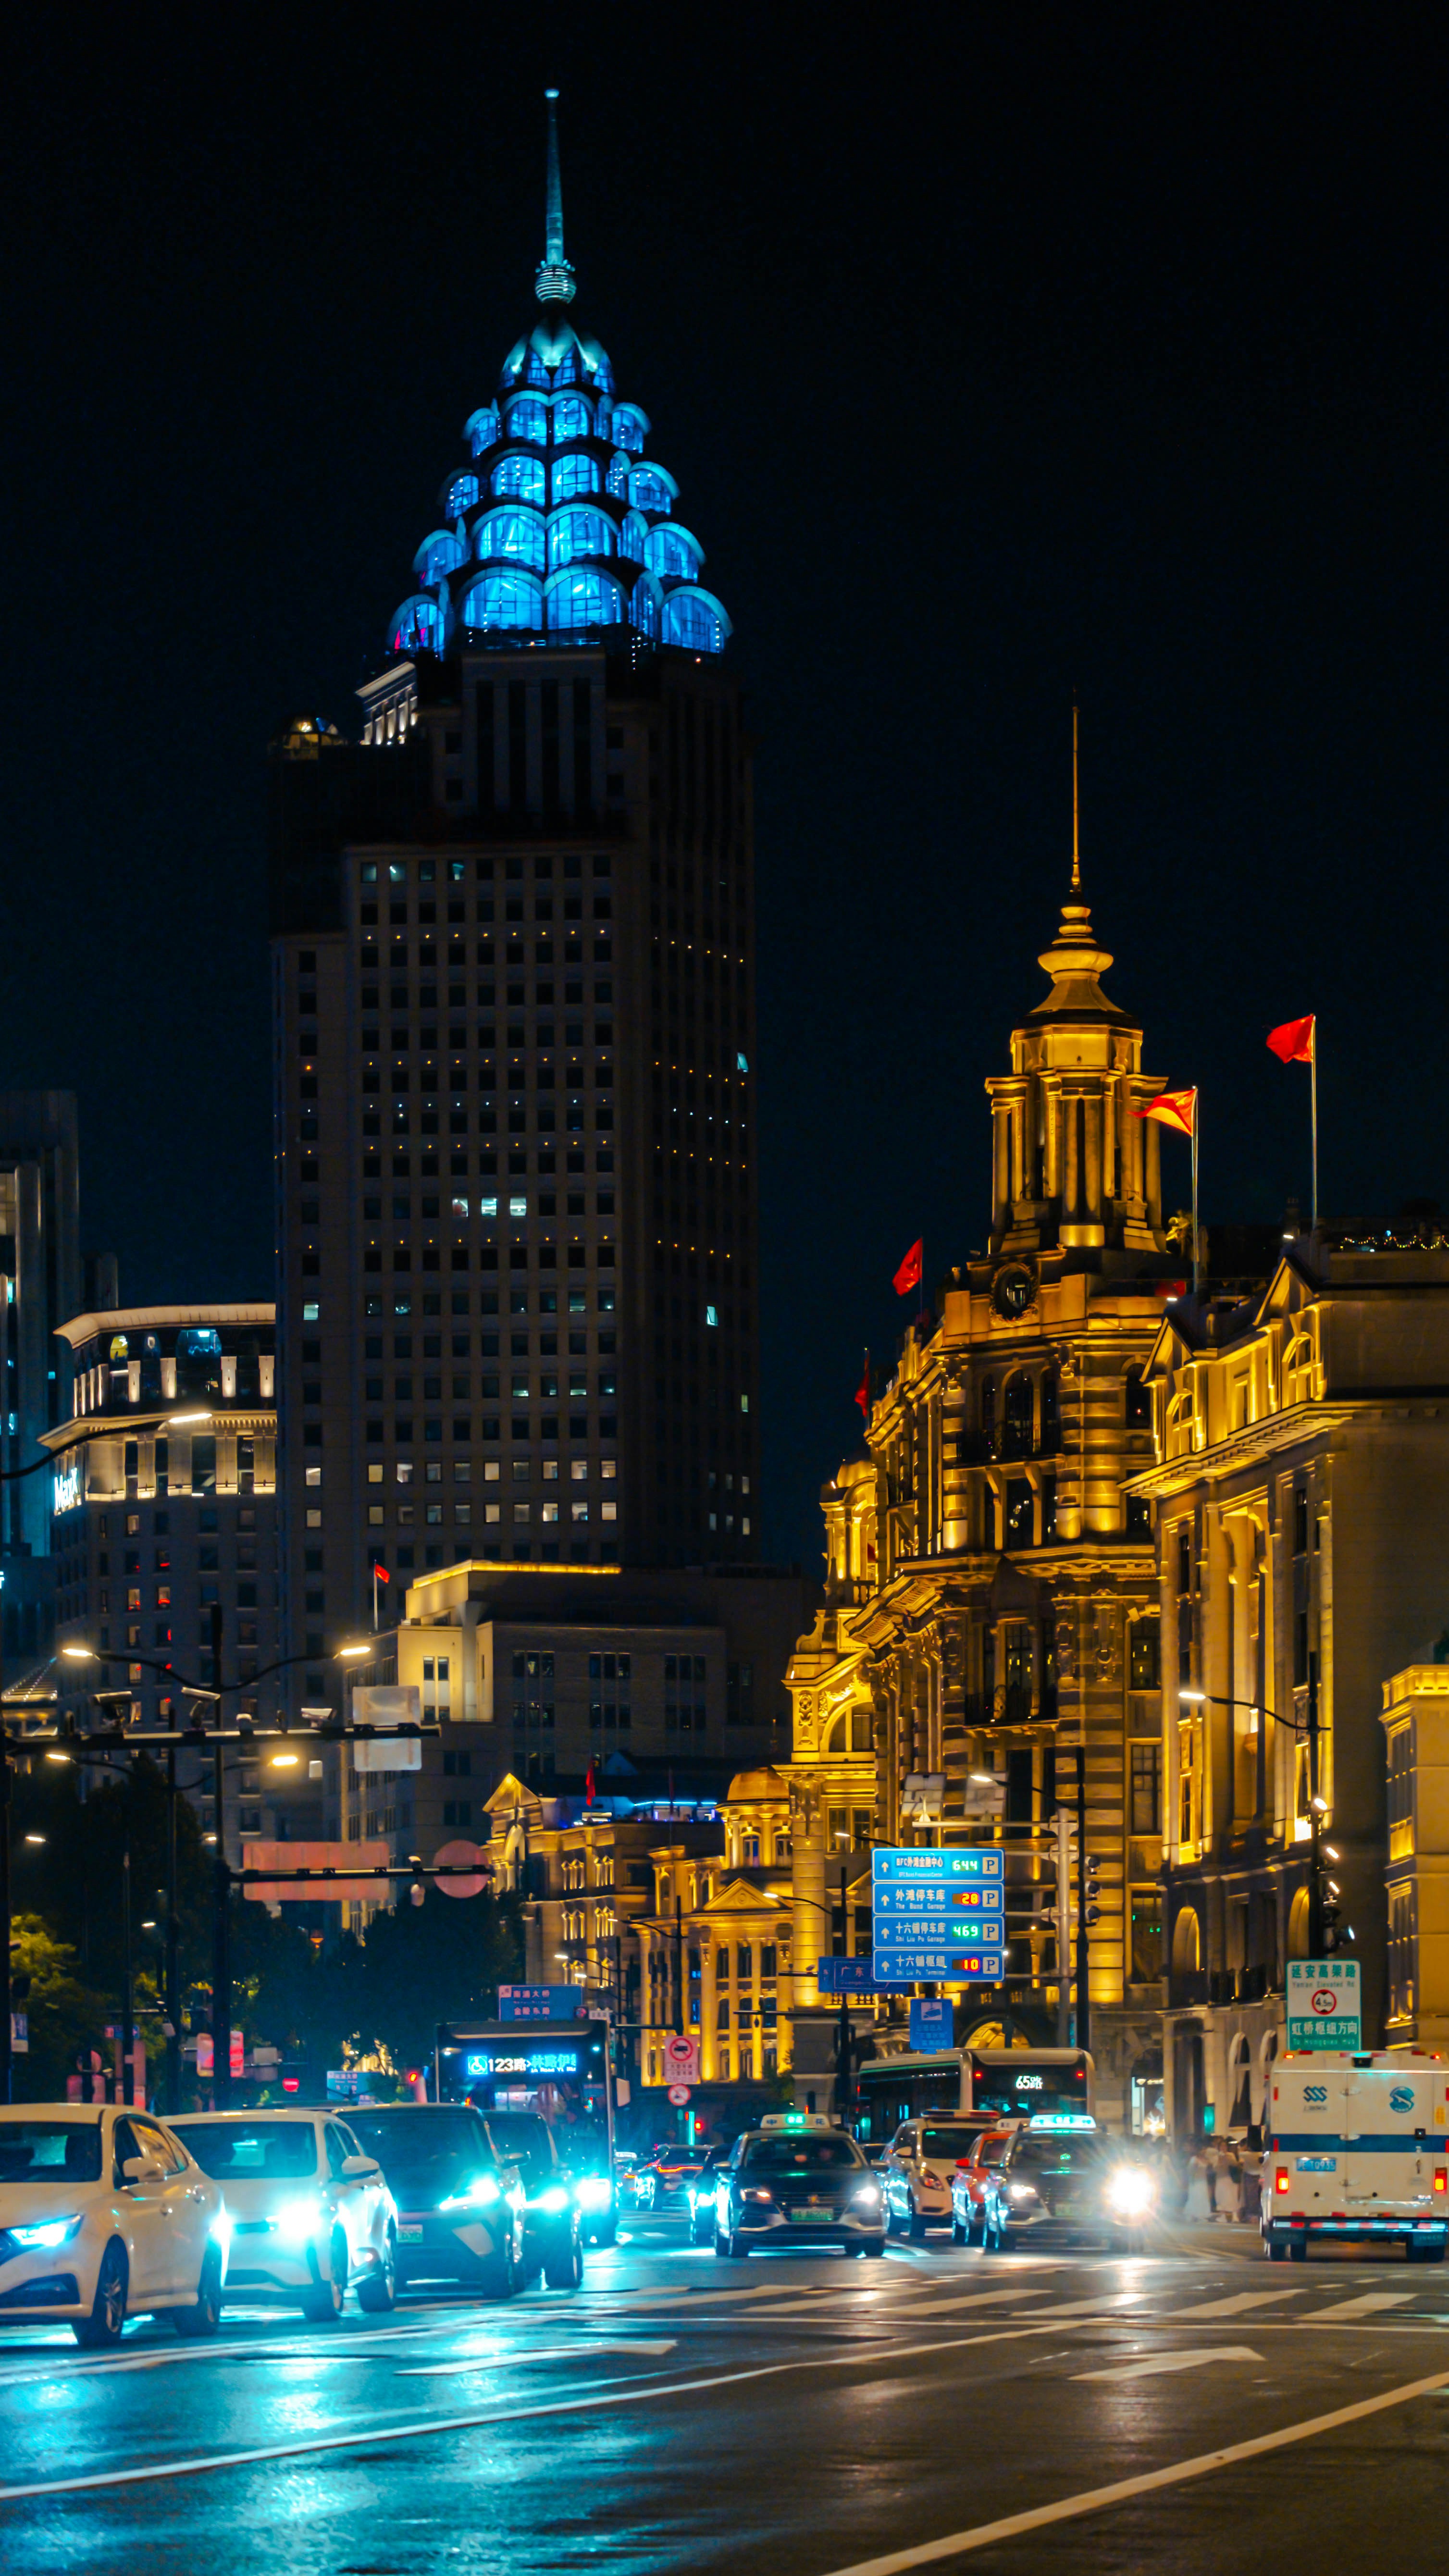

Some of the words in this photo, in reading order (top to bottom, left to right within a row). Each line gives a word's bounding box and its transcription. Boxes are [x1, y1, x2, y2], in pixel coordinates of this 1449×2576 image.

[953, 1860, 978, 1870] 644
[986, 1860, 995, 1871] P
[896, 1889, 945, 1902] 外滩停车库
[987, 1893, 995, 1904] P
[896, 1922, 946, 1934] 十六铺停车库
[954, 1926, 978, 1936] 469
[987, 1926, 995, 1938] P
[964, 1959, 978, 1970] 10
[987, 1960, 995, 1971] P
[1291, 1965, 1356, 1978] 延安高架路
[1316, 1997, 1332, 2006] 4.5m
[1291, 2021, 1358, 2035] 虹桥枢纽方向
[488, 2057, 526, 2072] 123路
[1016, 2075, 1043, 2089] 65路
